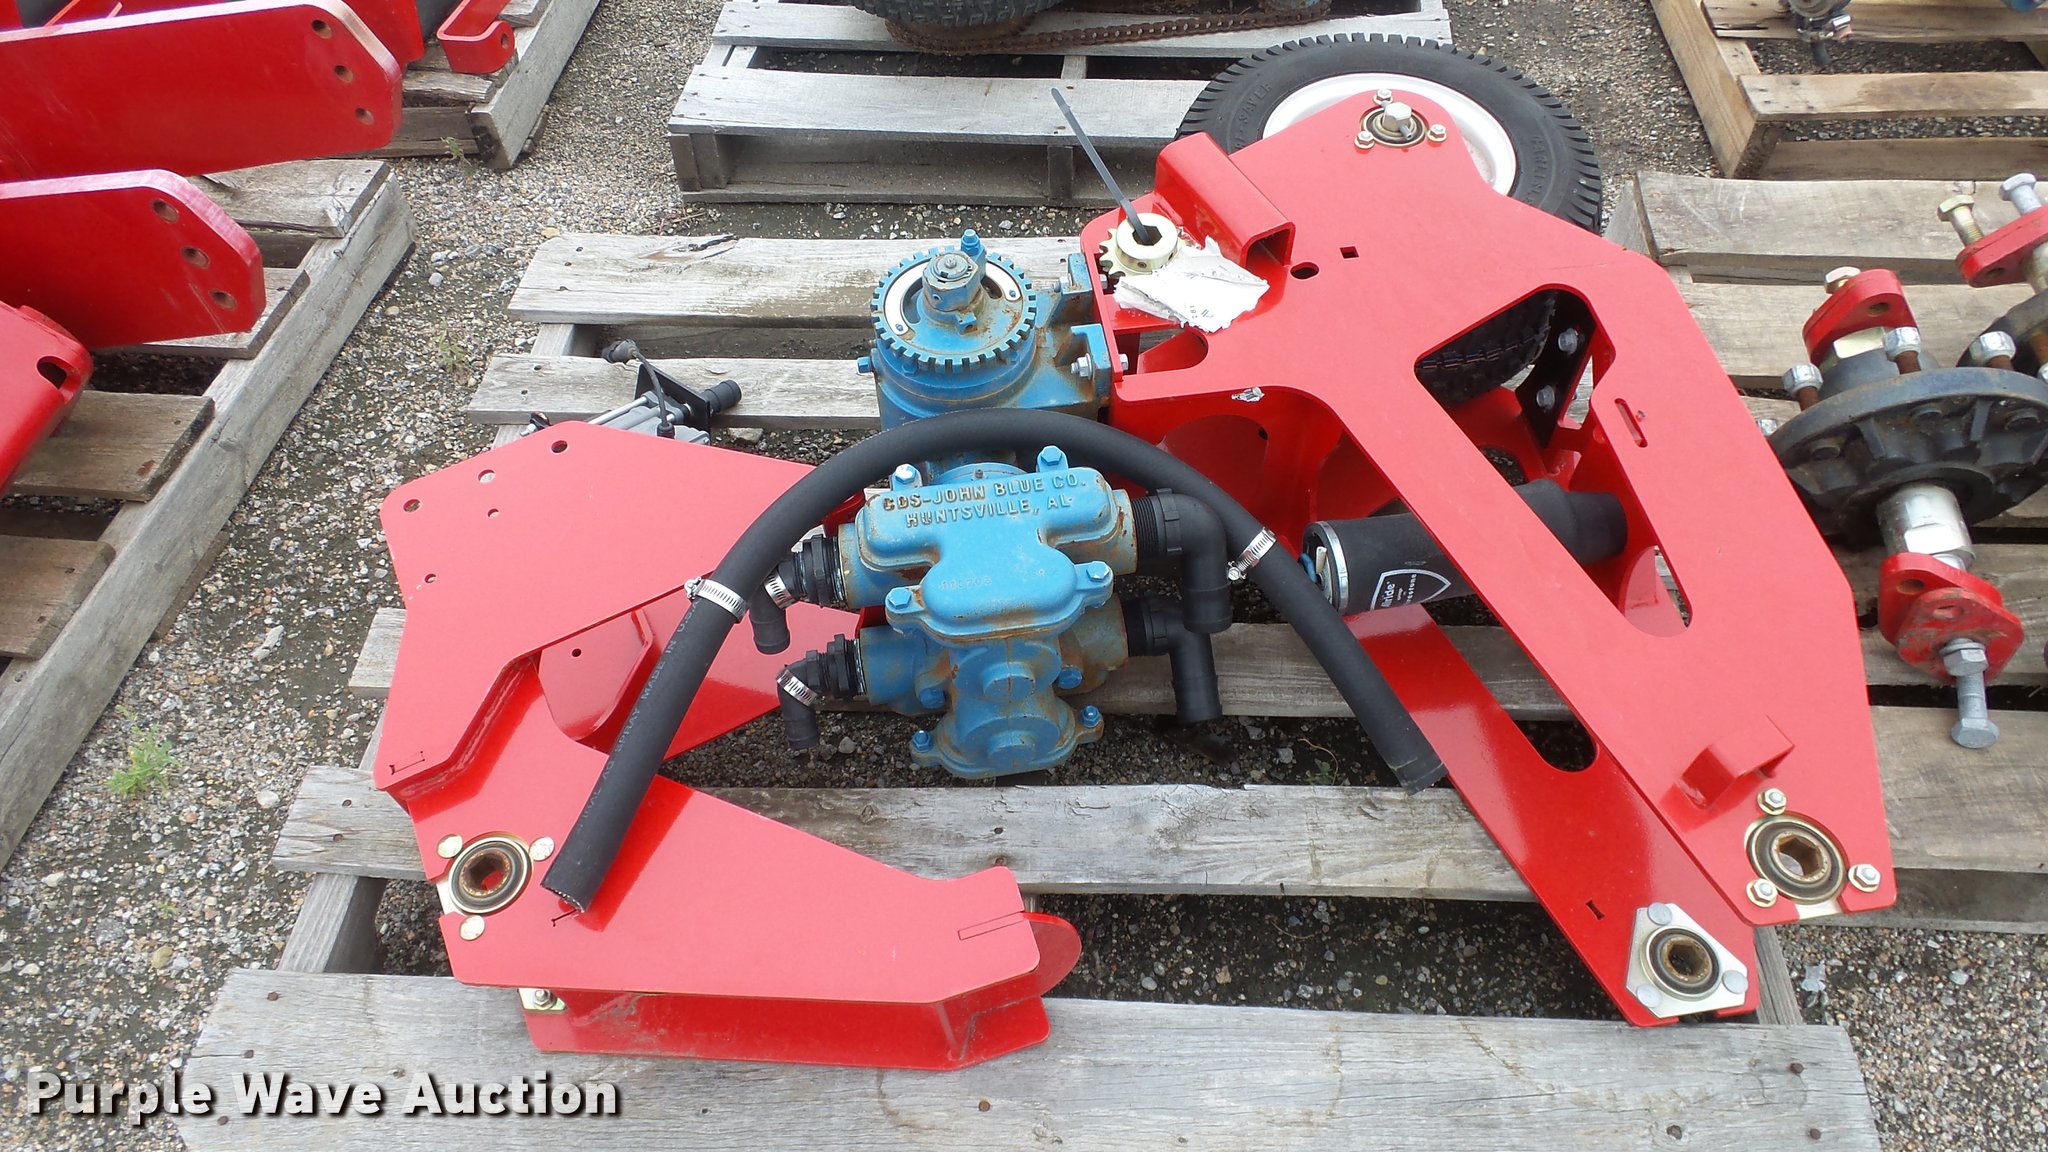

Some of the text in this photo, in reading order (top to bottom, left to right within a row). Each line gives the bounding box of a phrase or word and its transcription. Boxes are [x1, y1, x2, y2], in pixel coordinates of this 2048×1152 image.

[883, 473, 1087, 512] CDS-JOHN BLUE CO.
[906, 497, 1040, 529] HUNTSVILLE,
[615, 707, 640, 753] SPRAY
[641, 660, 666, 700] MADE
[665, 640, 677, 654] IN
